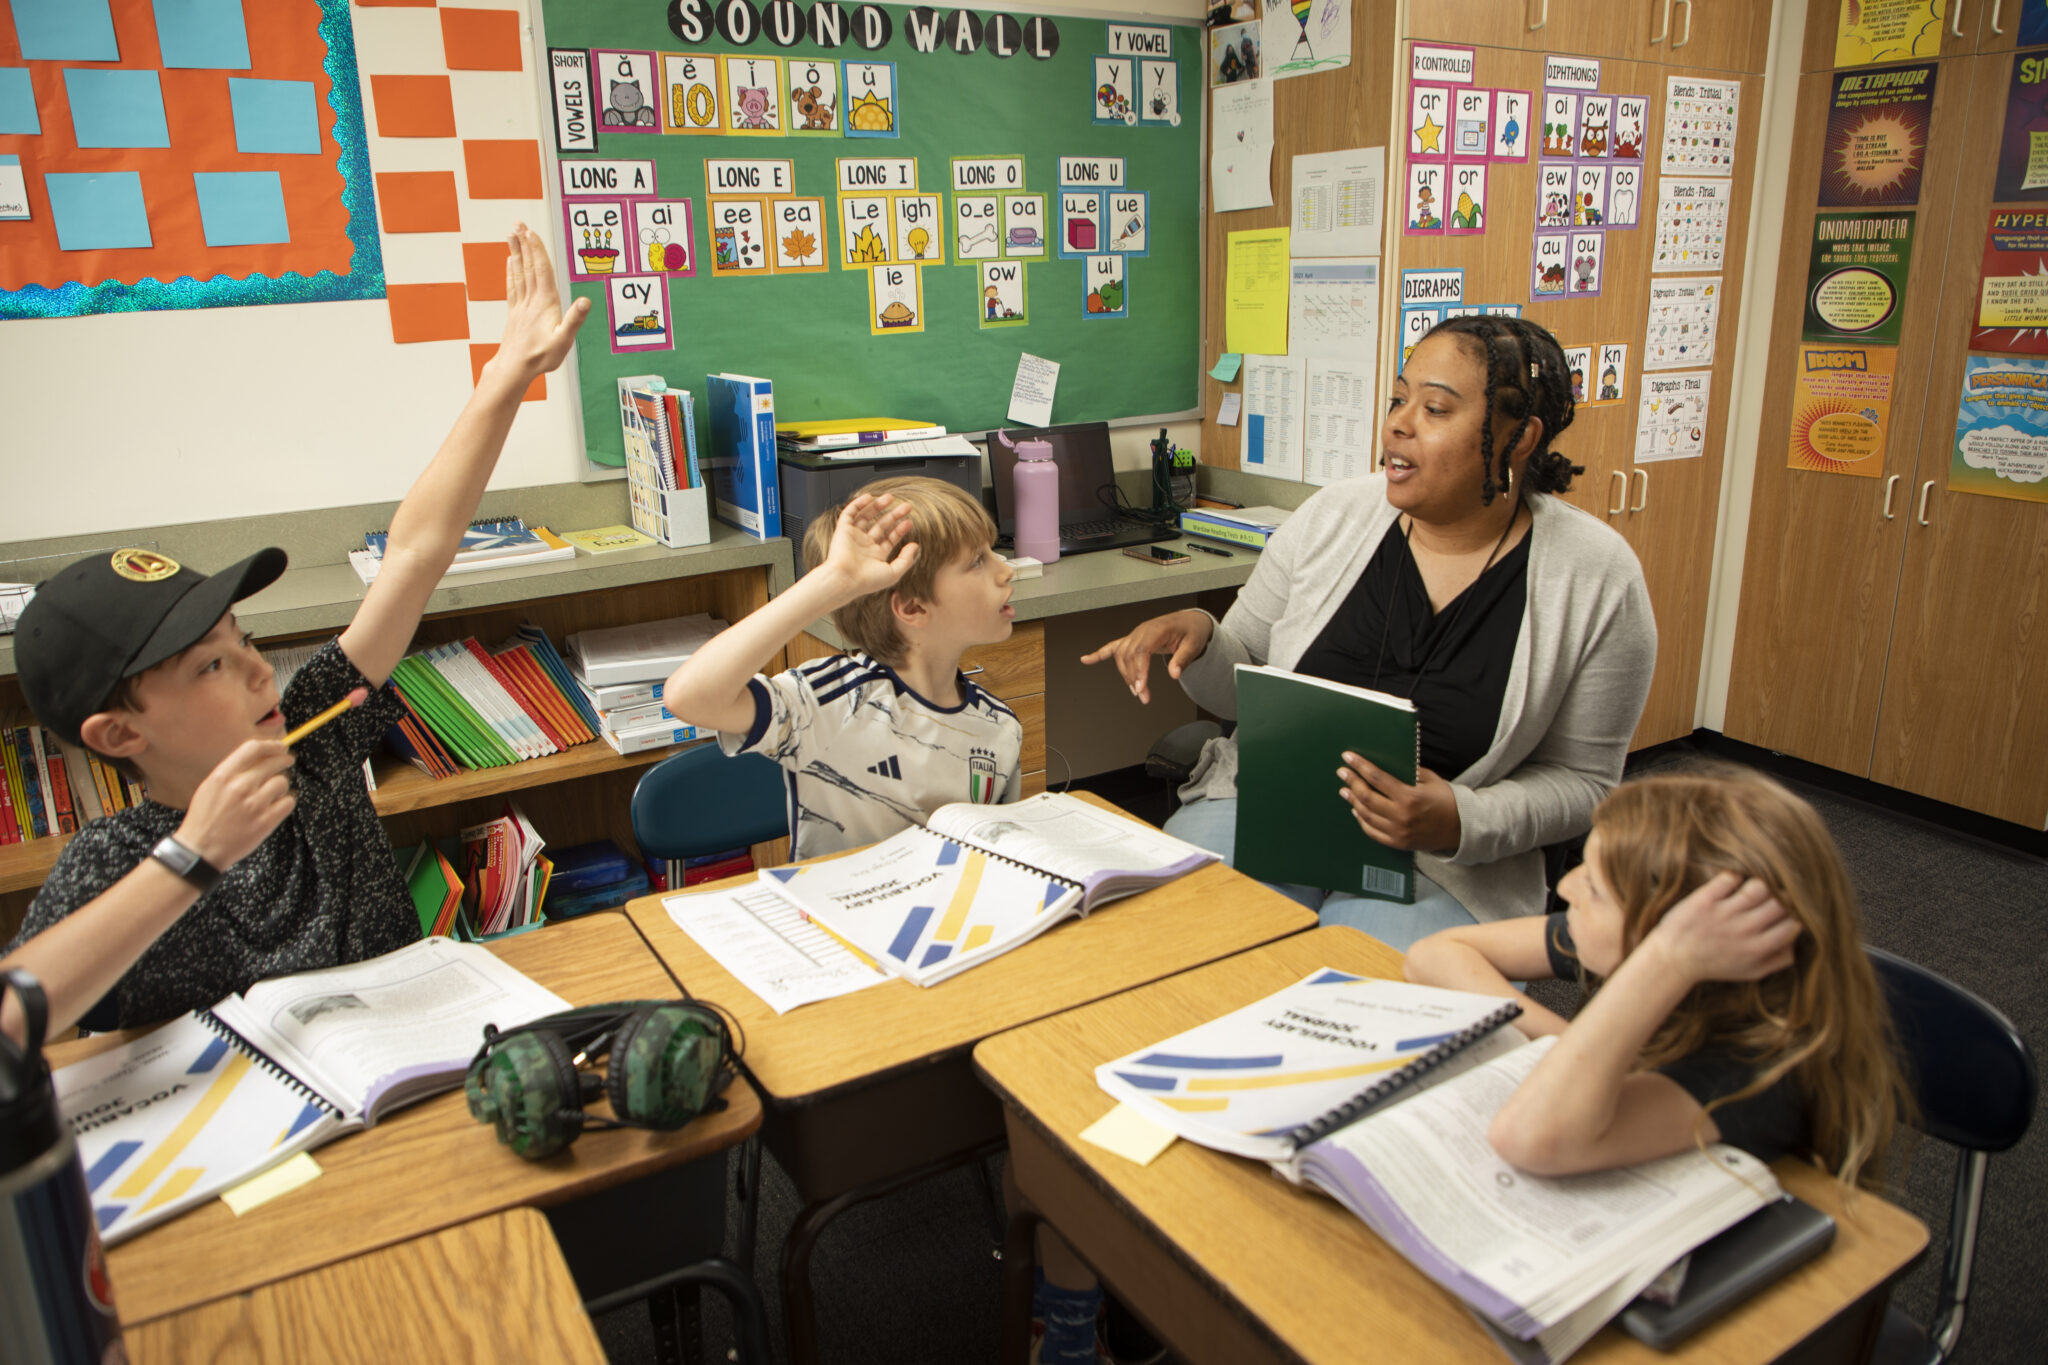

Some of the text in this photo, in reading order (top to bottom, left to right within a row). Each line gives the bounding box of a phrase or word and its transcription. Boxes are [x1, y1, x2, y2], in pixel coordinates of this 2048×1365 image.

[679, 0, 1051, 58] SOUND WALL
[1115, 32, 1168, 53] Y VOWEL
[554, 55, 584, 69] SHORT
[1415, 55, 1471, 75] R CONTROLLED
[1547, 64, 1598, 83] DIPHTHONGS
[1840, 69, 1929, 91] METAPHOR
[1673, 85, 1722, 99] Blends Initial
[563, 80, 586, 142] VOWELS
[1421, 94, 1441, 111] ar
[1463, 96, 1482, 111] er
[1506, 95, 1519, 113] ir
[1555, 99, 1568, 115] oi
[1586, 101, 1607, 117] ow
[1620, 103, 1642, 118] aw
[570, 167, 646, 189] LONG A
[718, 167, 783, 188] LONG E
[848, 165, 907, 185] LONG I
[959, 164, 1016, 185] LONG O
[1066, 163, 1118, 181] LONG U
[1418, 170, 1438, 186] ur
[1459, 170, 1478, 186] or
[1546, 171, 1567, 186] ew
[1582, 170, 1601, 191] oy
[1616, 170, 1633, 185] oo
[1673, 186, 1694, 198] Blends
[902, 199, 931, 223] igh
[1012, 199, 1036, 216] oa
[1117, 197, 1138, 213] ue
[652, 206, 672, 225] ai
[724, 208, 752, 224] ee
[784, 206, 811, 222] ea
[1819, 218, 1908, 241] ONOMATOPOEIA
[1542, 240, 1560, 256] au
[1577, 239, 1596, 254] ou
[989, 265, 1015, 281] ow
[1098, 257, 1113, 275] ui
[887, 267, 903, 286] ie
[622, 282, 651, 304] ay
[1405, 278, 1460, 298] DIGRAPHS
[1411, 312, 1431, 332] ch
[1567, 352, 1586, 366] wr
[1604, 346, 1621, 363] kn
[1807, 351, 1866, 369] IDIOM
[1651, 380, 1680, 393] Digraphs
[972, 760, 994, 773] ITALIA
